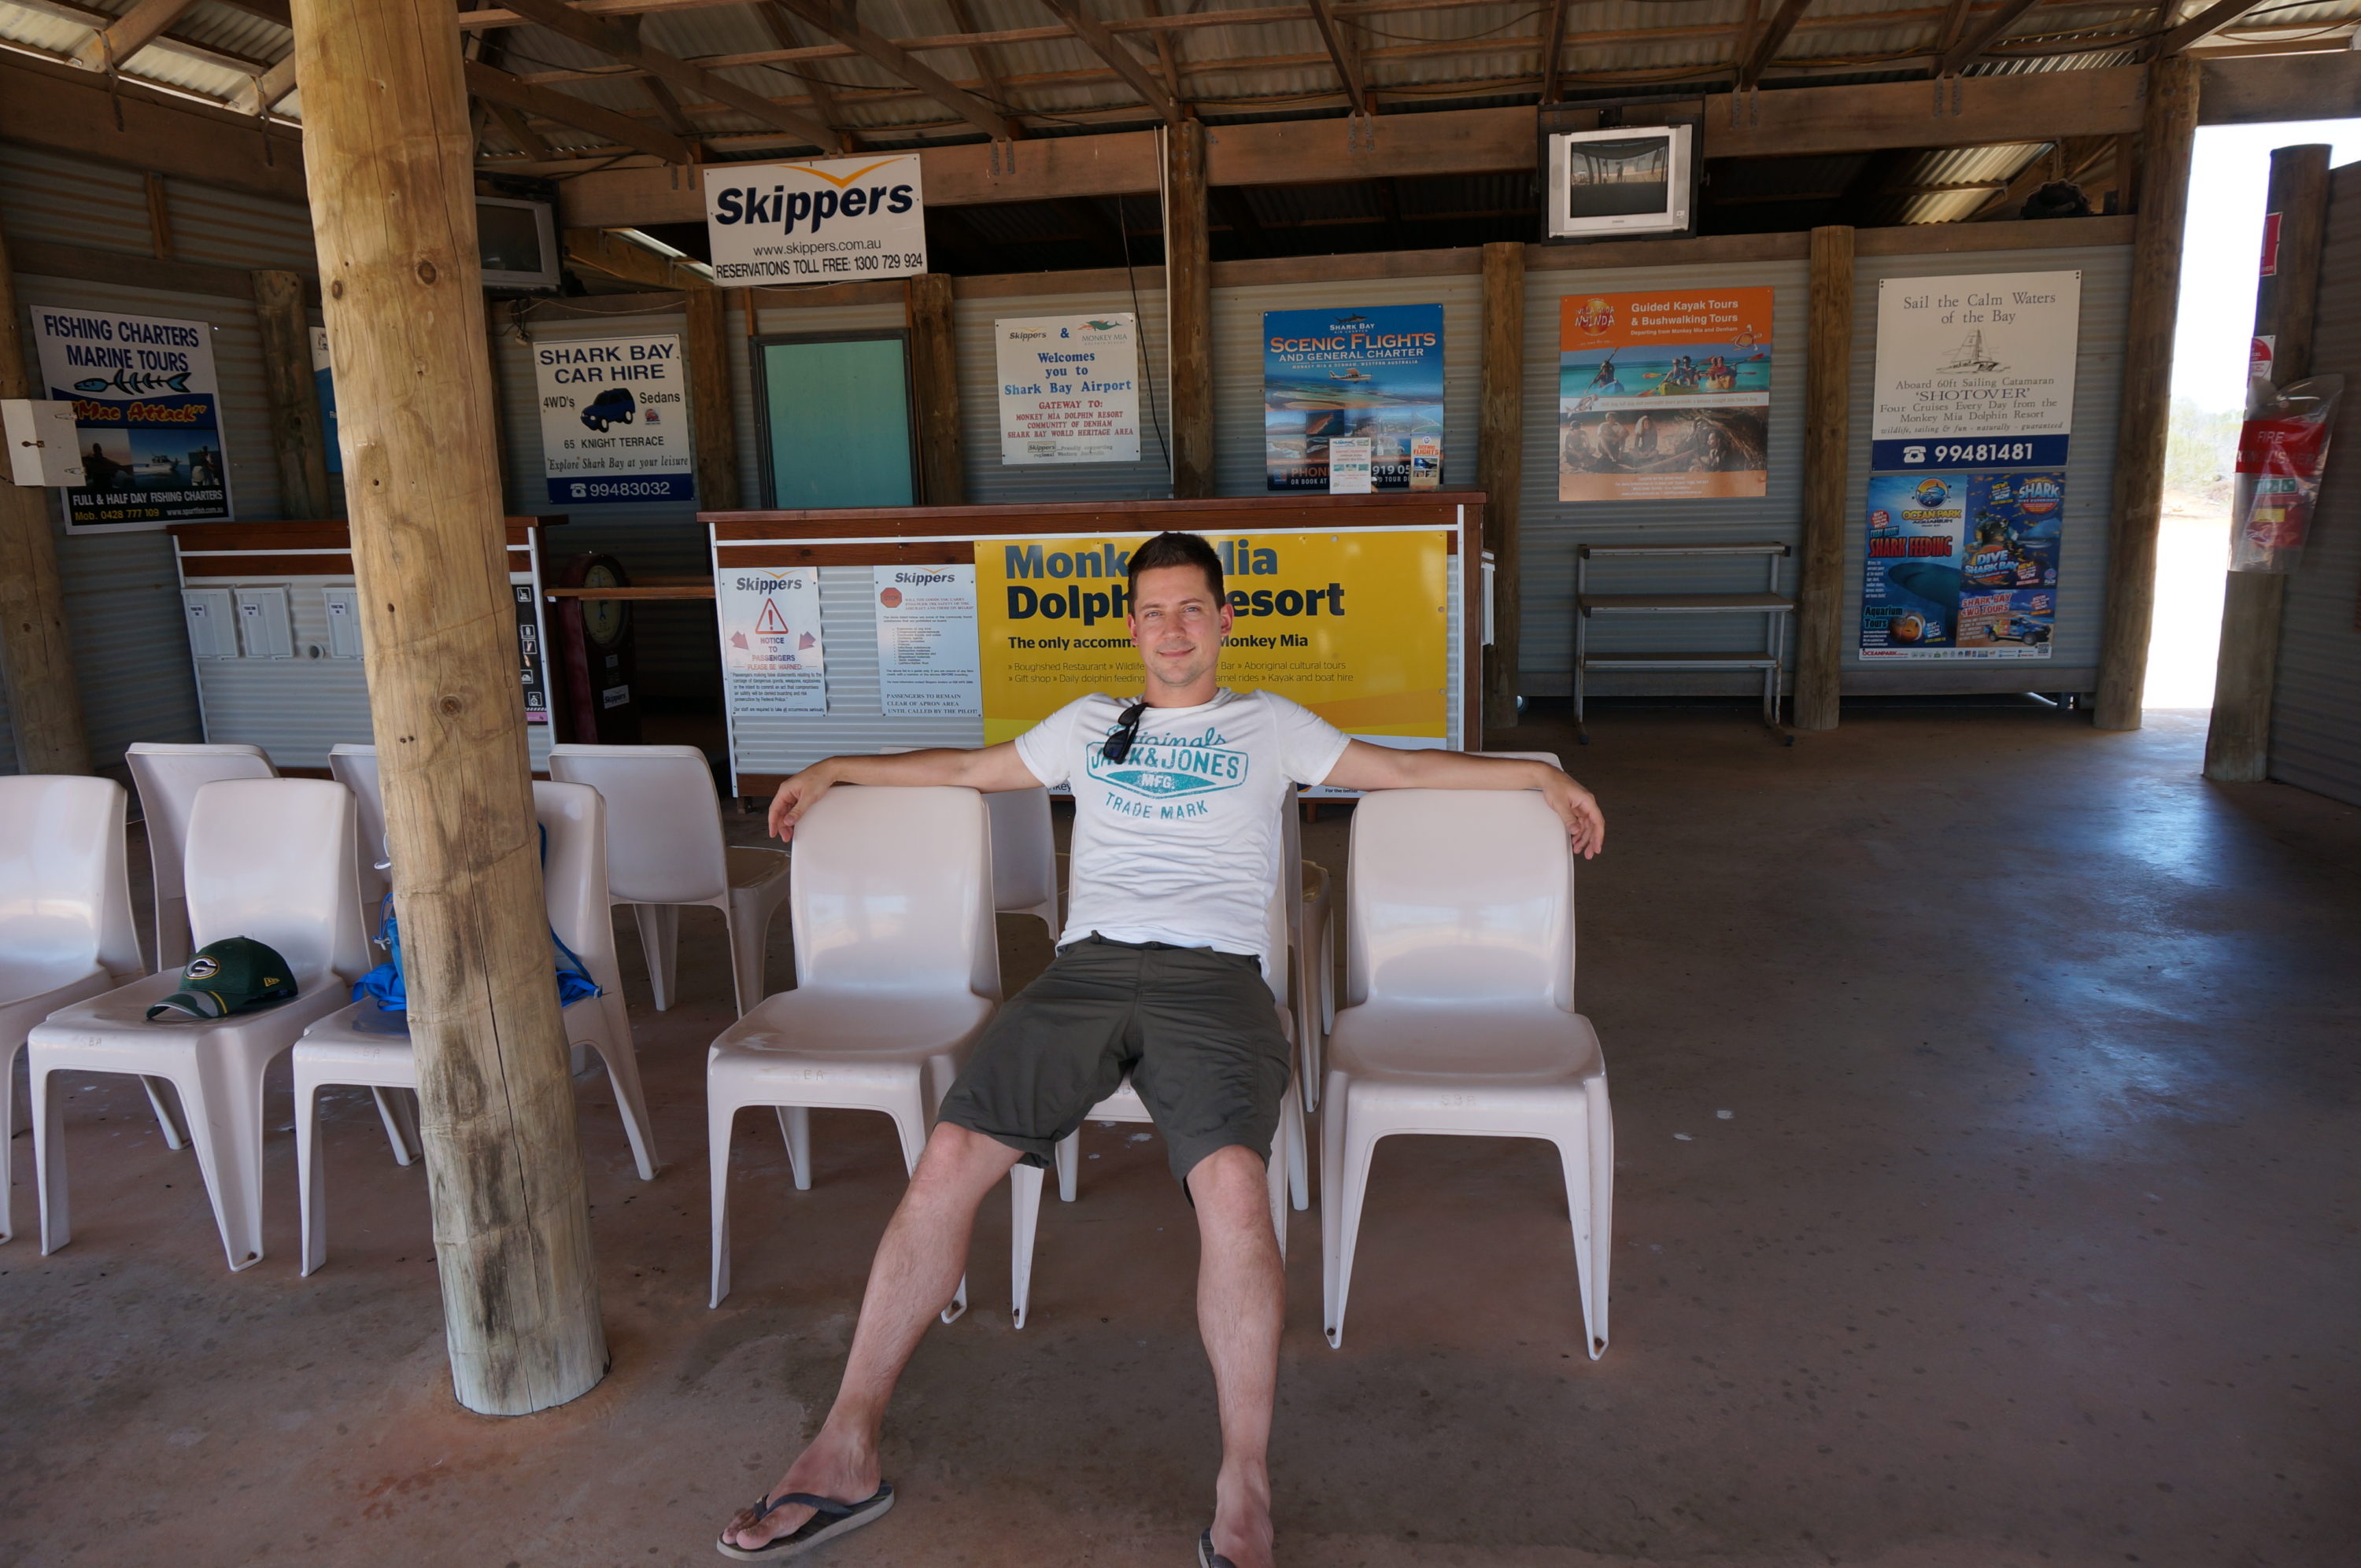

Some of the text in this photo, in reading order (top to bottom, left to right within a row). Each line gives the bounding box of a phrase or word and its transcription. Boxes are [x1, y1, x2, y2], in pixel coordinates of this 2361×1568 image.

[715, 184, 914, 235] Skippers
[753, 239, 881, 256] www.skippers.com.au
[715, 253, 923, 279] RESERVATIONS TOLL FREE: 1300 729 924
[1631, 300, 1738, 312] Guided Kayak Tours
[1903, 291, 2056, 309] Sail the Calm Waters
[1631, 314, 1738, 326] & Bushwalking Tours
[1941, 310, 2016, 324] of the Bay
[44, 315, 198, 348] FISHING CHARTERS
[1009, 331, 1047, 341] Skippers
[1060, 327, 1070, 338] &
[1269, 333, 1436, 353] SCENIC FLIGHTS
[66, 345, 189, 372] MARINE TOURS
[540, 344, 674, 365] SHARK BAY
[1037, 352, 1096, 363] Welcomes
[1279, 349, 1424, 362] AND GENERAL CHARTER
[554, 364, 665, 384] CAR HIRE
[1045, 365, 1088, 378] you to
[1004, 380, 1131, 396] Shark Bay Airport
[1896, 377, 2054, 389] Aboard 60ft Sailing Catamaran
[543, 392, 680, 408] 4WD's Sedans
[1039, 400, 1081, 409] GATEWAY
[1880, 398, 2058, 413] Four Cruises Every Day from the
[1900, 410, 2044, 423] Monkey Mia Dolphin Resort
[563, 436, 664, 449] 65 KNIGHT TERRACE
[2257, 431, 2285, 445] FIRE
[1934, 443, 2033, 462] 99481481
[549, 456, 688, 473] Explore Shark Bay at your leisure
[590, 481, 671, 497] 99483032
[2019, 481, 2060, 499] SHARK
[1901, 509, 1962, 520] OCEAN PARK
[1869, 536, 1953, 557] SHARK FEEDING
[1005, 544, 1130, 579] Monk
[1977, 550, 2008, 565] DIVE
[1964, 563, 1997, 574] SHARK
[737, 577, 802, 595] Skippers
[895, 573, 955, 585] Skippers
[1007, 583, 1345, 625] Dolph esort
[1961, 592, 2013, 607] SHARK BAY
[1864, 605, 1904, 617] Aquarium
[1982, 603, 2009, 614] TOURS
[1864, 618, 1888, 629] Tours
[1008, 636, 1035, 648] The
[1038, 636, 1070, 651] only
[1280, 634, 1308, 647] Mia
[1014, 662, 1060, 672] Boughshed
[1062, 662, 1107, 670] Restaurant
[1221, 662, 1235, 670] Bar
[1244, 661, 1288, 671] Aboriginal
[1106, 792, 1208, 819] TRADE MARK
